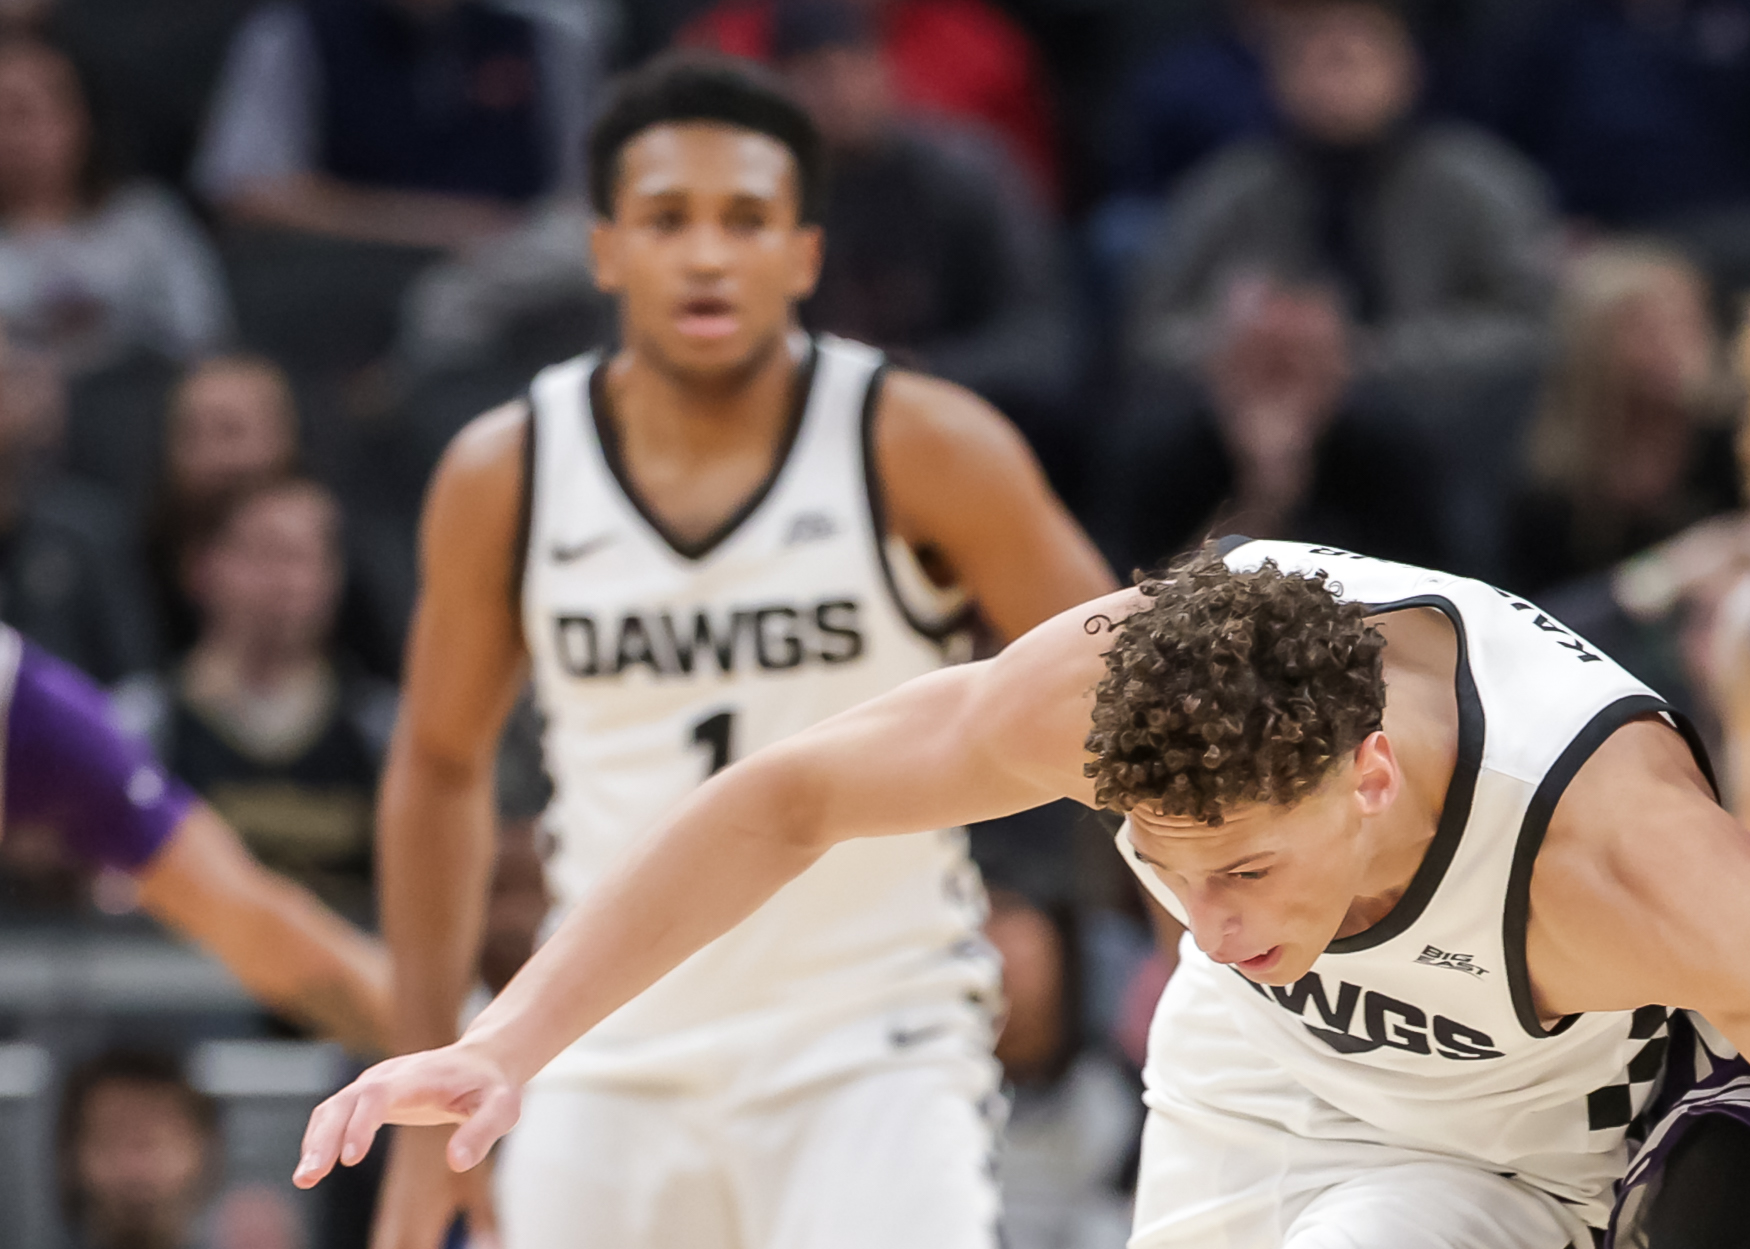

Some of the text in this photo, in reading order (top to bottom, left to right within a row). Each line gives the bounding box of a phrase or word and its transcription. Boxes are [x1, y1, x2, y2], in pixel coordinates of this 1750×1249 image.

[554, 601, 863, 677] DAWGS
[693, 711, 735, 778] 1
[1413, 955, 1490, 976] EAST
[1421, 944, 1475, 962] BIG
